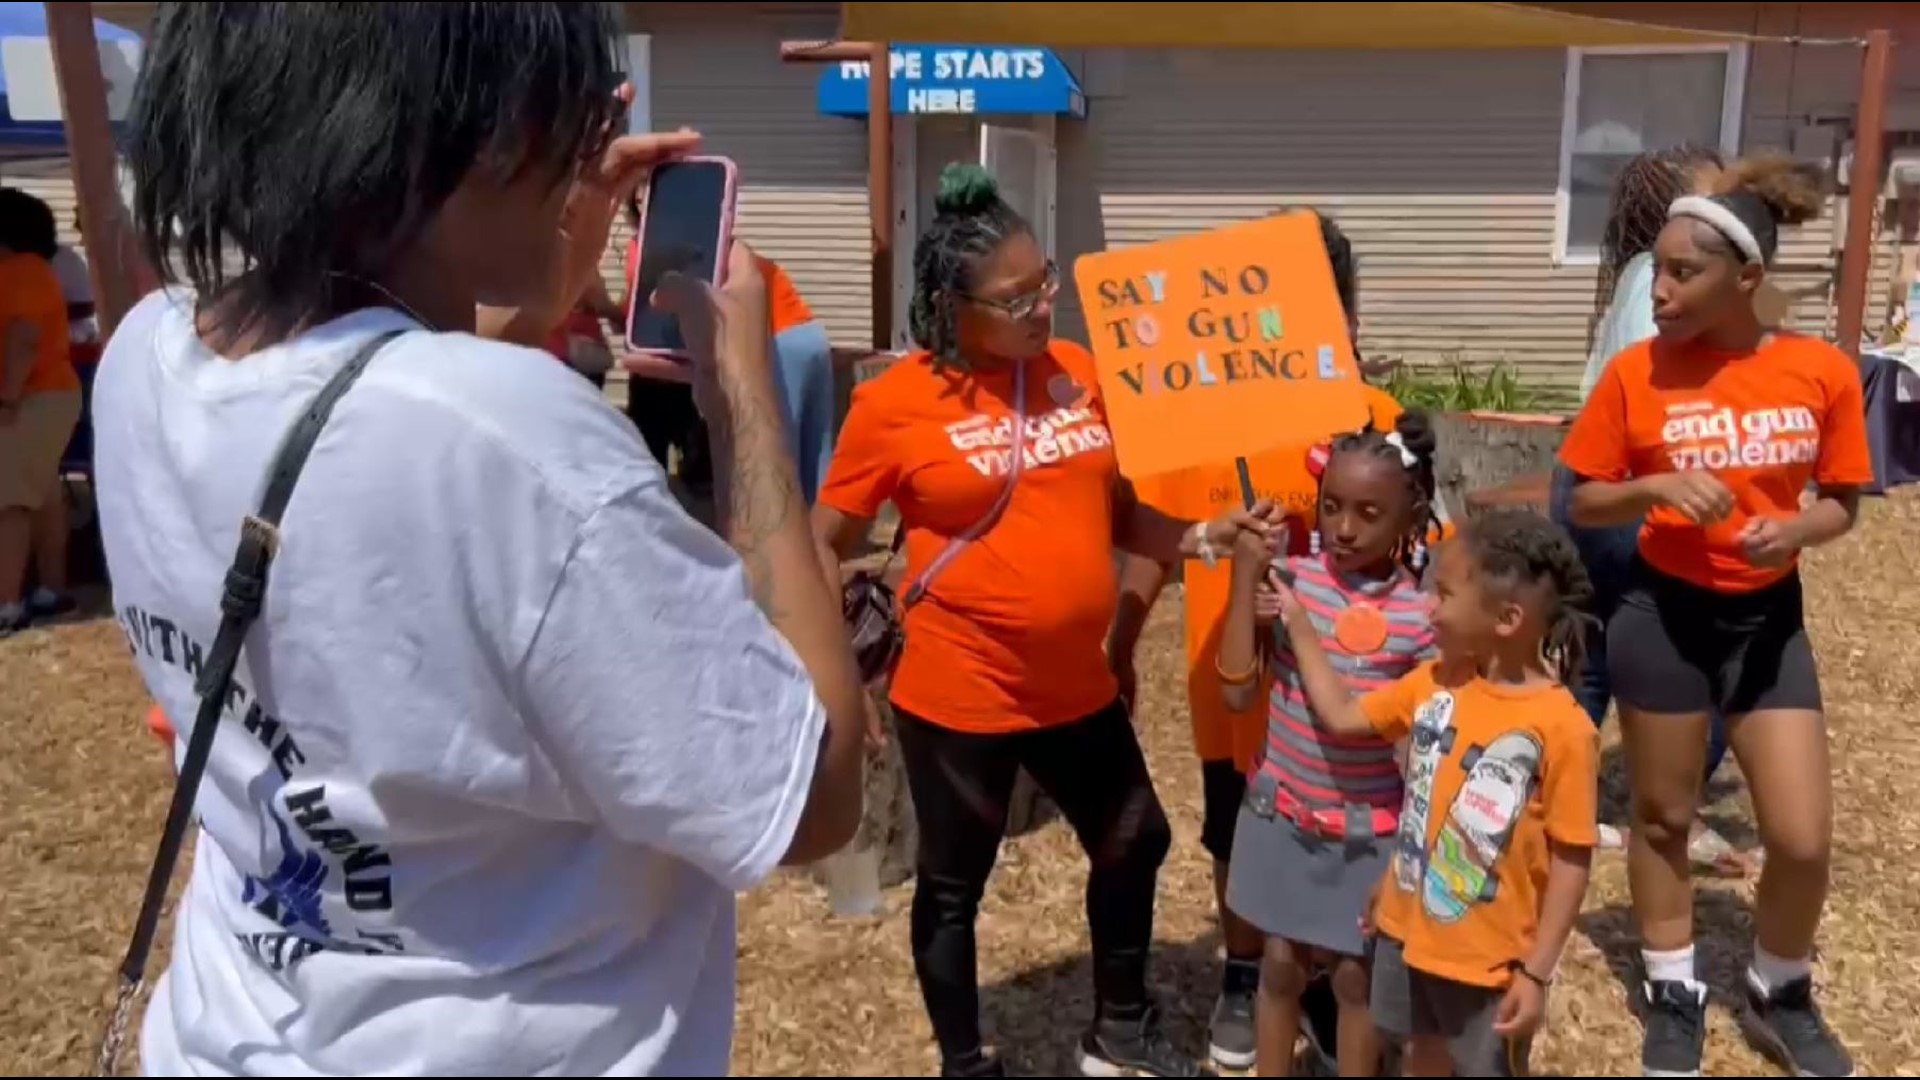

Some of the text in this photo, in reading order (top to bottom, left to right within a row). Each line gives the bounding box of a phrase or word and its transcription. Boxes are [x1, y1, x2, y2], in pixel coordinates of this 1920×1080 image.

[840, 50, 1045, 80] HPE STARTS
[907, 89, 977, 114] HERE
[1098, 264, 1270, 310] SAY NO
[1107, 304, 1285, 349] TO GUN
[1117, 344, 1347, 398] VIOLENCE
[1662, 406, 1816, 444] end gun
[284, 784, 392, 912] HAND
